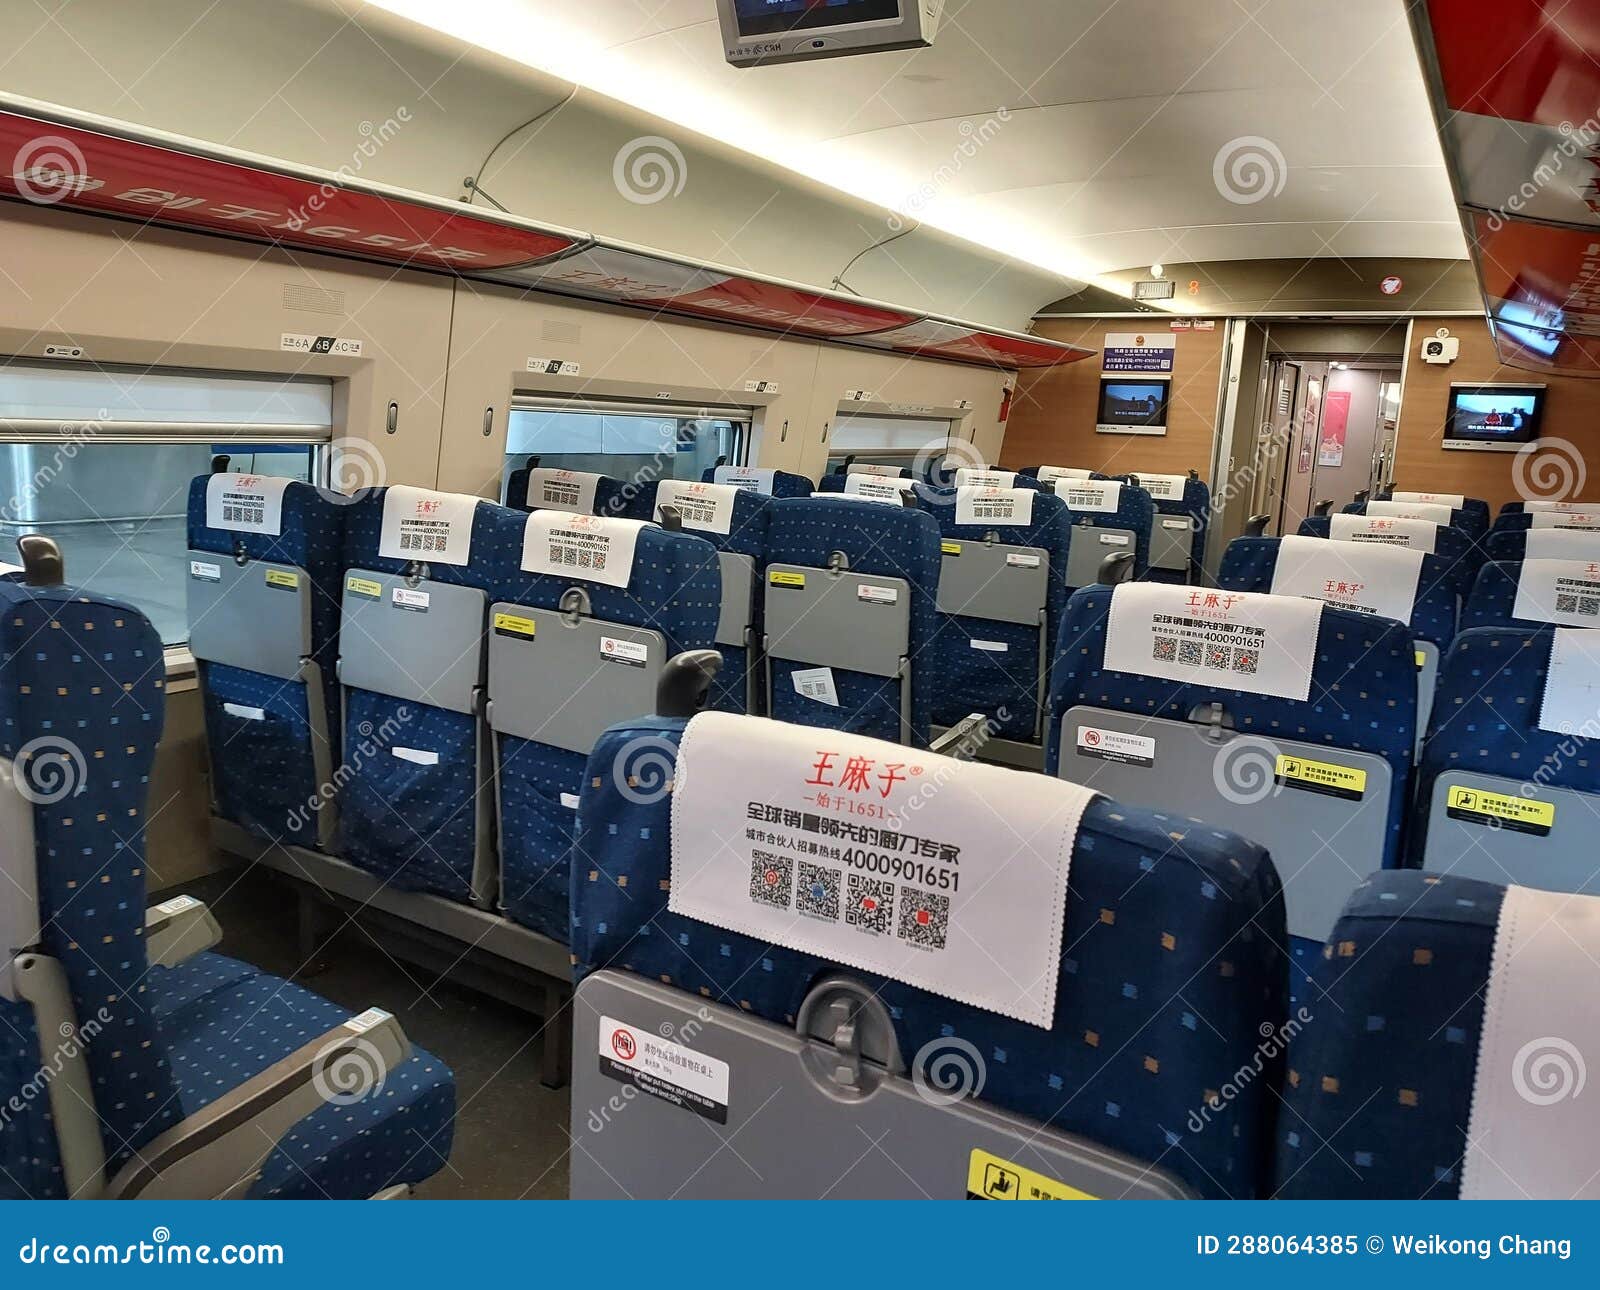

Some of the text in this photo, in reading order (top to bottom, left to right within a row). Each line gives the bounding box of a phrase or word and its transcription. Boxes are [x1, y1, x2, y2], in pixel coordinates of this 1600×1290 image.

[295, 338, 309, 348] 6A
[315, 340, 330, 351] 6B
[335, 342, 348, 352] 6C
[1185, 591, 1238, 610] 王麻子
[1203, 632, 1265, 648] 4000901651
[746, 801, 961, 865] 全球销量领先的厨刀专家
[745, 826, 959, 892] 城市合伙人招募热线 4000901651
